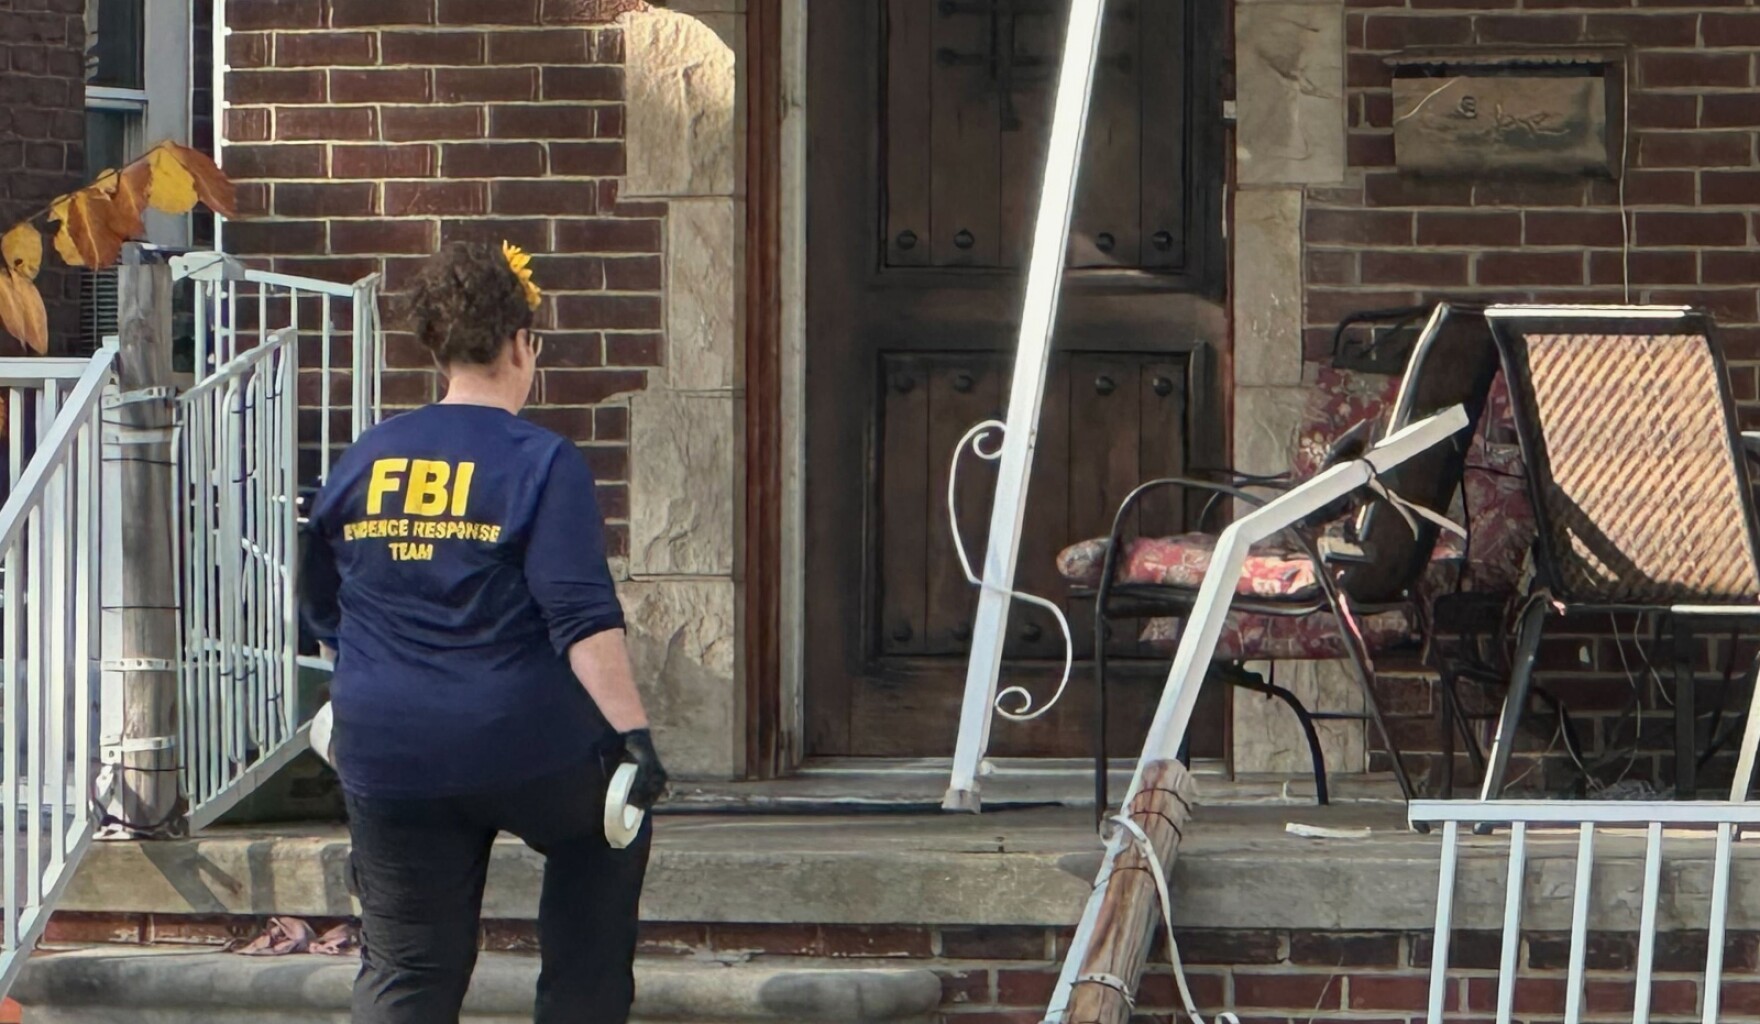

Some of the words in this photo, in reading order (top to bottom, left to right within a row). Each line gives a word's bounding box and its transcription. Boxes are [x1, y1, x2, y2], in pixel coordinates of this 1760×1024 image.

[366, 458, 475, 517] FBI
[413, 521, 502, 543] RESPONSE
[388, 542, 434, 561] TEAM
